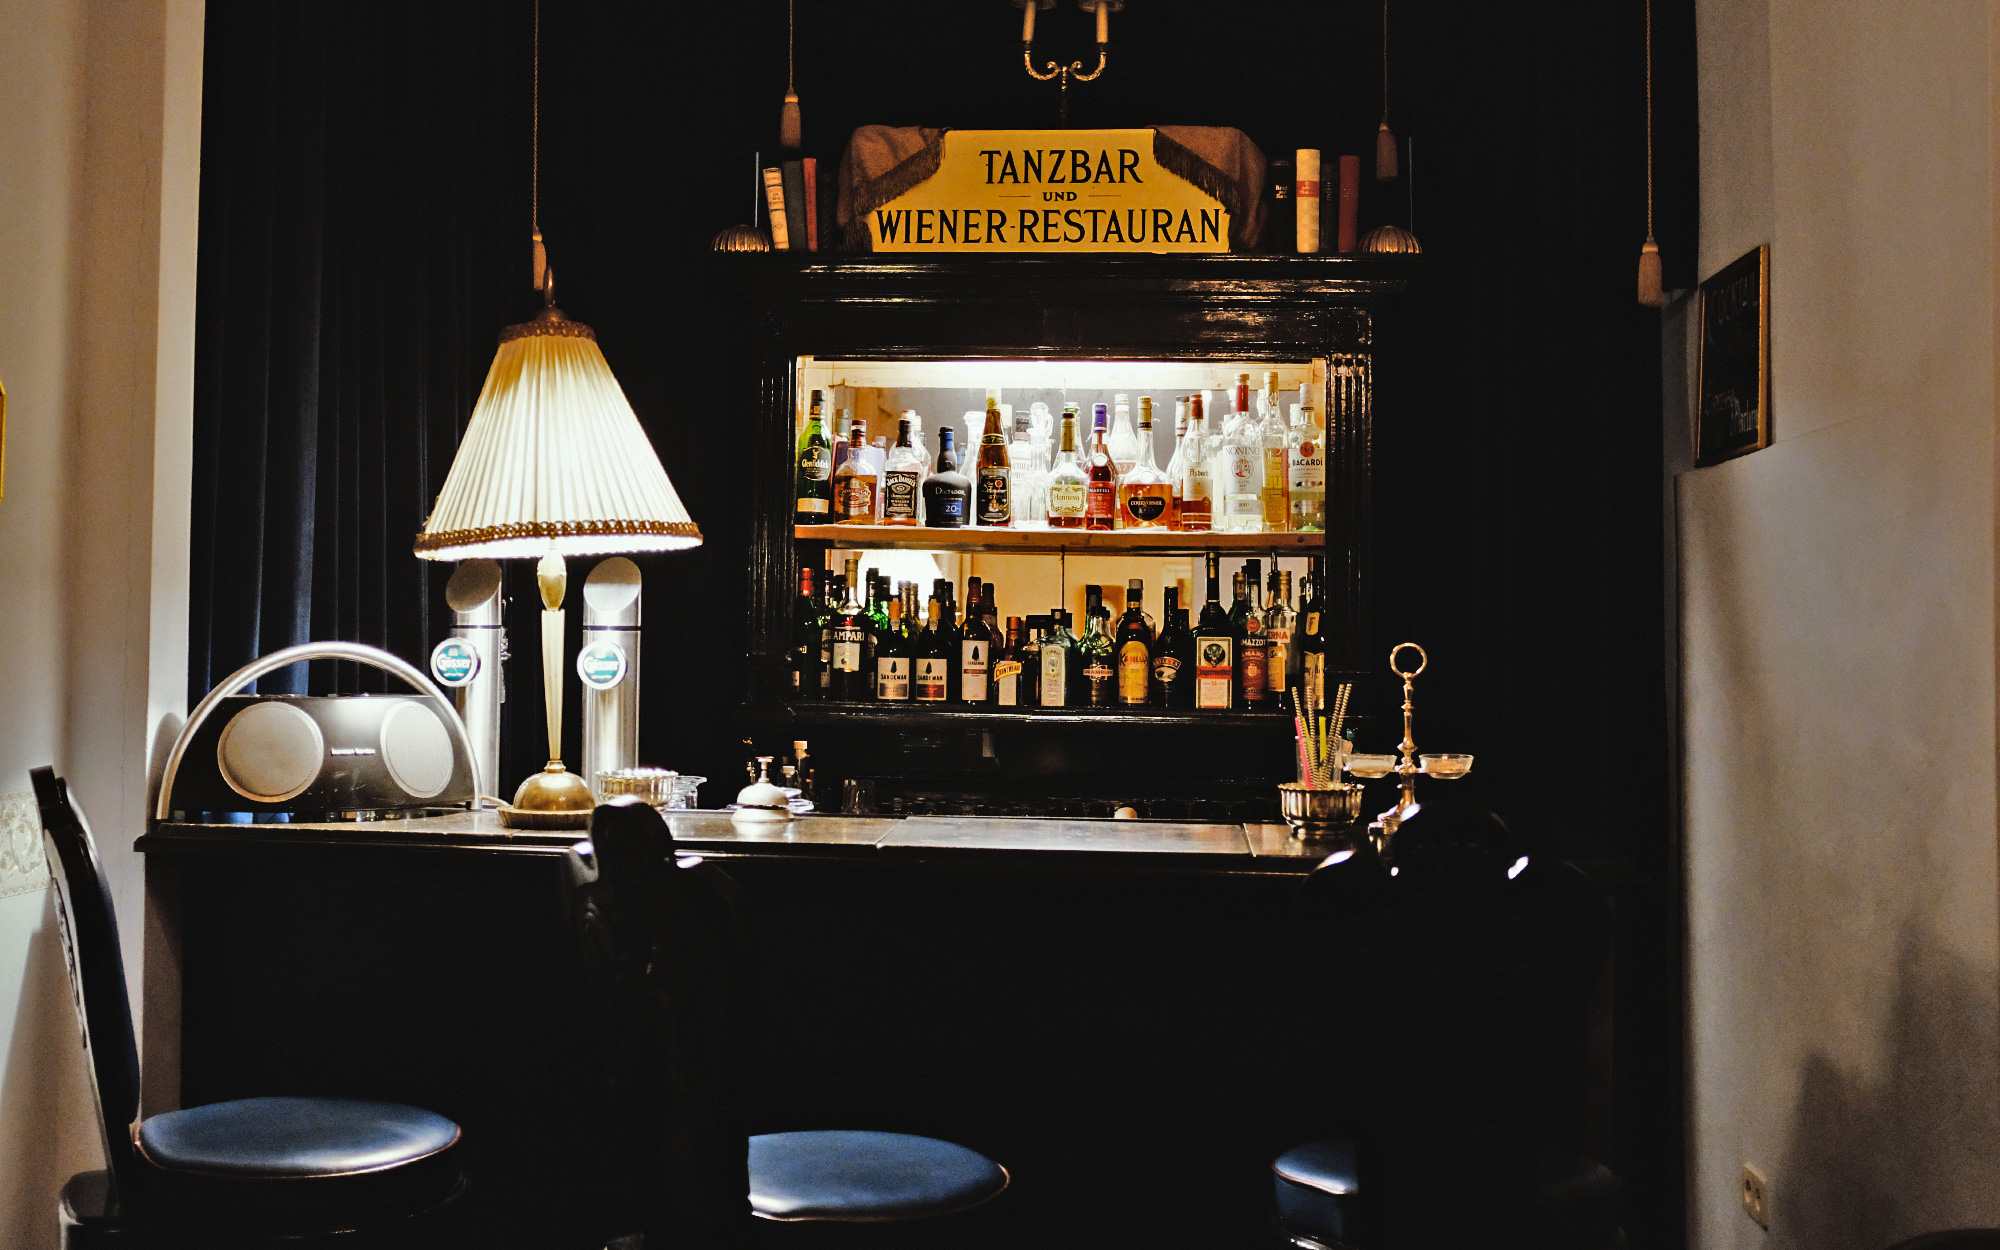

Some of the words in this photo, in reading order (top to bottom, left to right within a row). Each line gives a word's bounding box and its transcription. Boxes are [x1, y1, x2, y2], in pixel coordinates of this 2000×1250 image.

[979, 149, 1144, 184] TANZBAR
[1042, 191, 1078, 202] UND
[875, 208, 1221, 244] WIENER-RESTAURAN
[1225, 446, 1261, 455] NONINO
[1292, 457, 1323, 467] BACARDÍ
[886, 477, 899, 487] JACK
[1053, 494, 1080, 502] Hennessy
[945, 505, 958, 513] 20
[833, 631, 865, 641] AMPARI
[1268, 631, 1289, 640] ERNA
[917, 674, 943, 682] SANDEMAN
